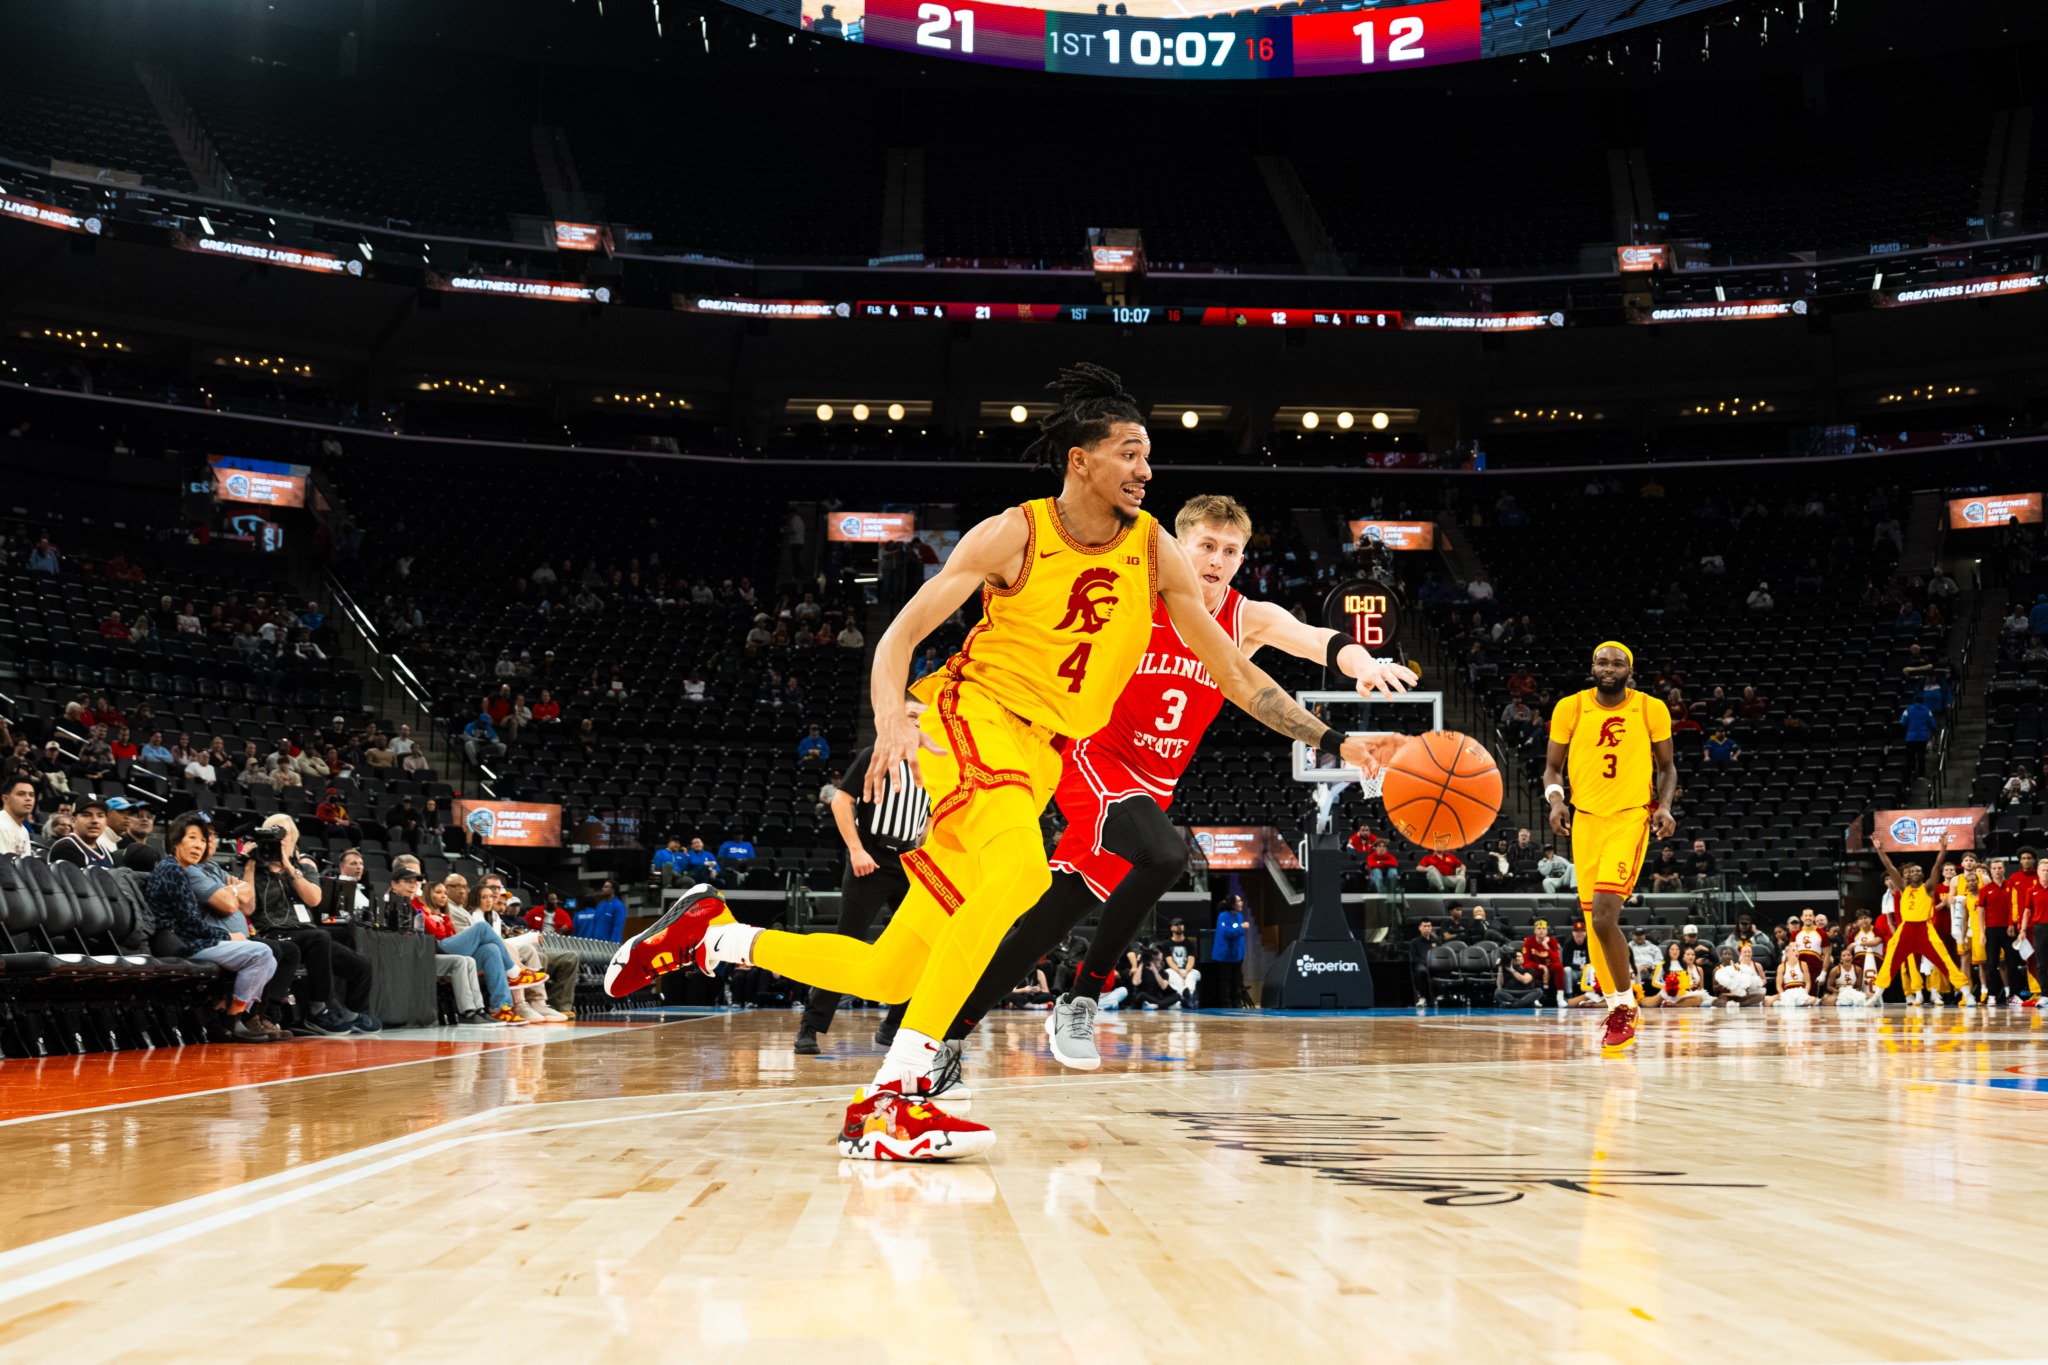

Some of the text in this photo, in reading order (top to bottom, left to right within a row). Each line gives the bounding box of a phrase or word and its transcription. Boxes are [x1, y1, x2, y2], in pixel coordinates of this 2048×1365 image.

[916, 4, 974, 53] 21
[1050, 29, 1274, 66] 1ST 10:07 16
[1352, 16, 1425, 64] 12
[4, 201, 38, 218] LIVES
[199, 238, 268, 259] GREATNESS
[268, 249, 303, 265] LIVES
[451, 277, 518, 293] GREATNESS
[518, 283, 552, 295] LIVES
[1897, 285, 1964, 302] GREATNESS
[1964, 282, 1998, 295] LIVES
[697, 299, 761, 313] GREATNESS
[760, 305, 793, 315] LIVES
[889, 304, 899, 317] 4
[933, 305, 943, 318] 4
[975, 306, 991, 320] 21
[1071, 307, 1181, 323] 1ST 10:07 16
[1652, 307, 1716, 321] GREATNESS
[1716, 305, 1748, 317] LIVES
[1271, 311, 1287, 325] 12
[1332, 313, 1342, 326] 4
[1414, 316, 1475, 328] GREATNESS
[1475, 317, 1507, 328] LIVES
[1344, 595, 1387, 614] 10:07
[1355, 613, 1384, 645] 16
[1057, 642, 1093, 694] 4
[1154, 688, 1188, 731] 3
[1133, 730, 1190, 759] STATE
[1602, 753, 1618, 779] 3
[497, 811, 548, 821] GREATNESS
[497, 820, 522, 829] LIVES
[1920, 816, 1974, 827] GREATNESS
